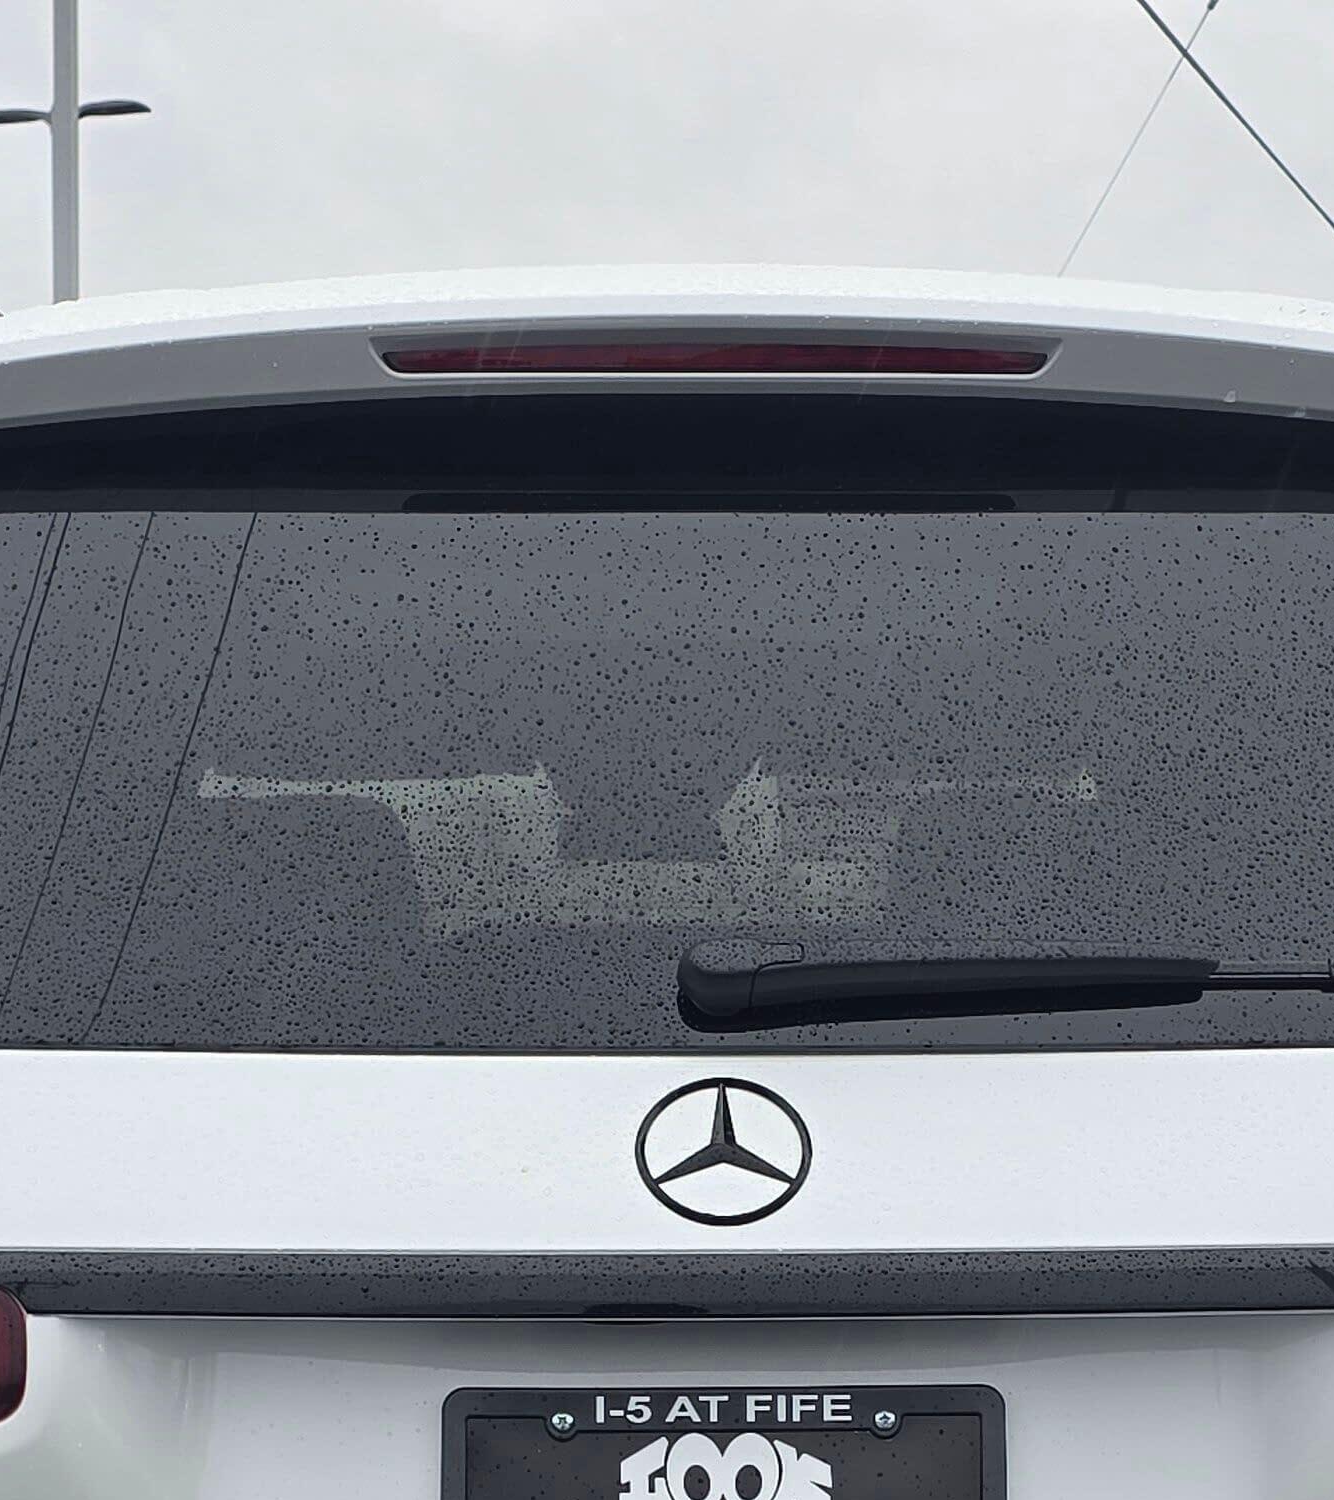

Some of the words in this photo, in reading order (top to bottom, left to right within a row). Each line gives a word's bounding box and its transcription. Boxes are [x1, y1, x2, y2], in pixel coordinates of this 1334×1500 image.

[595, 1395, 652, 1424] I-5
[666, 1395, 729, 1424] AT
[746, 1394, 853, 1423] FIFE
